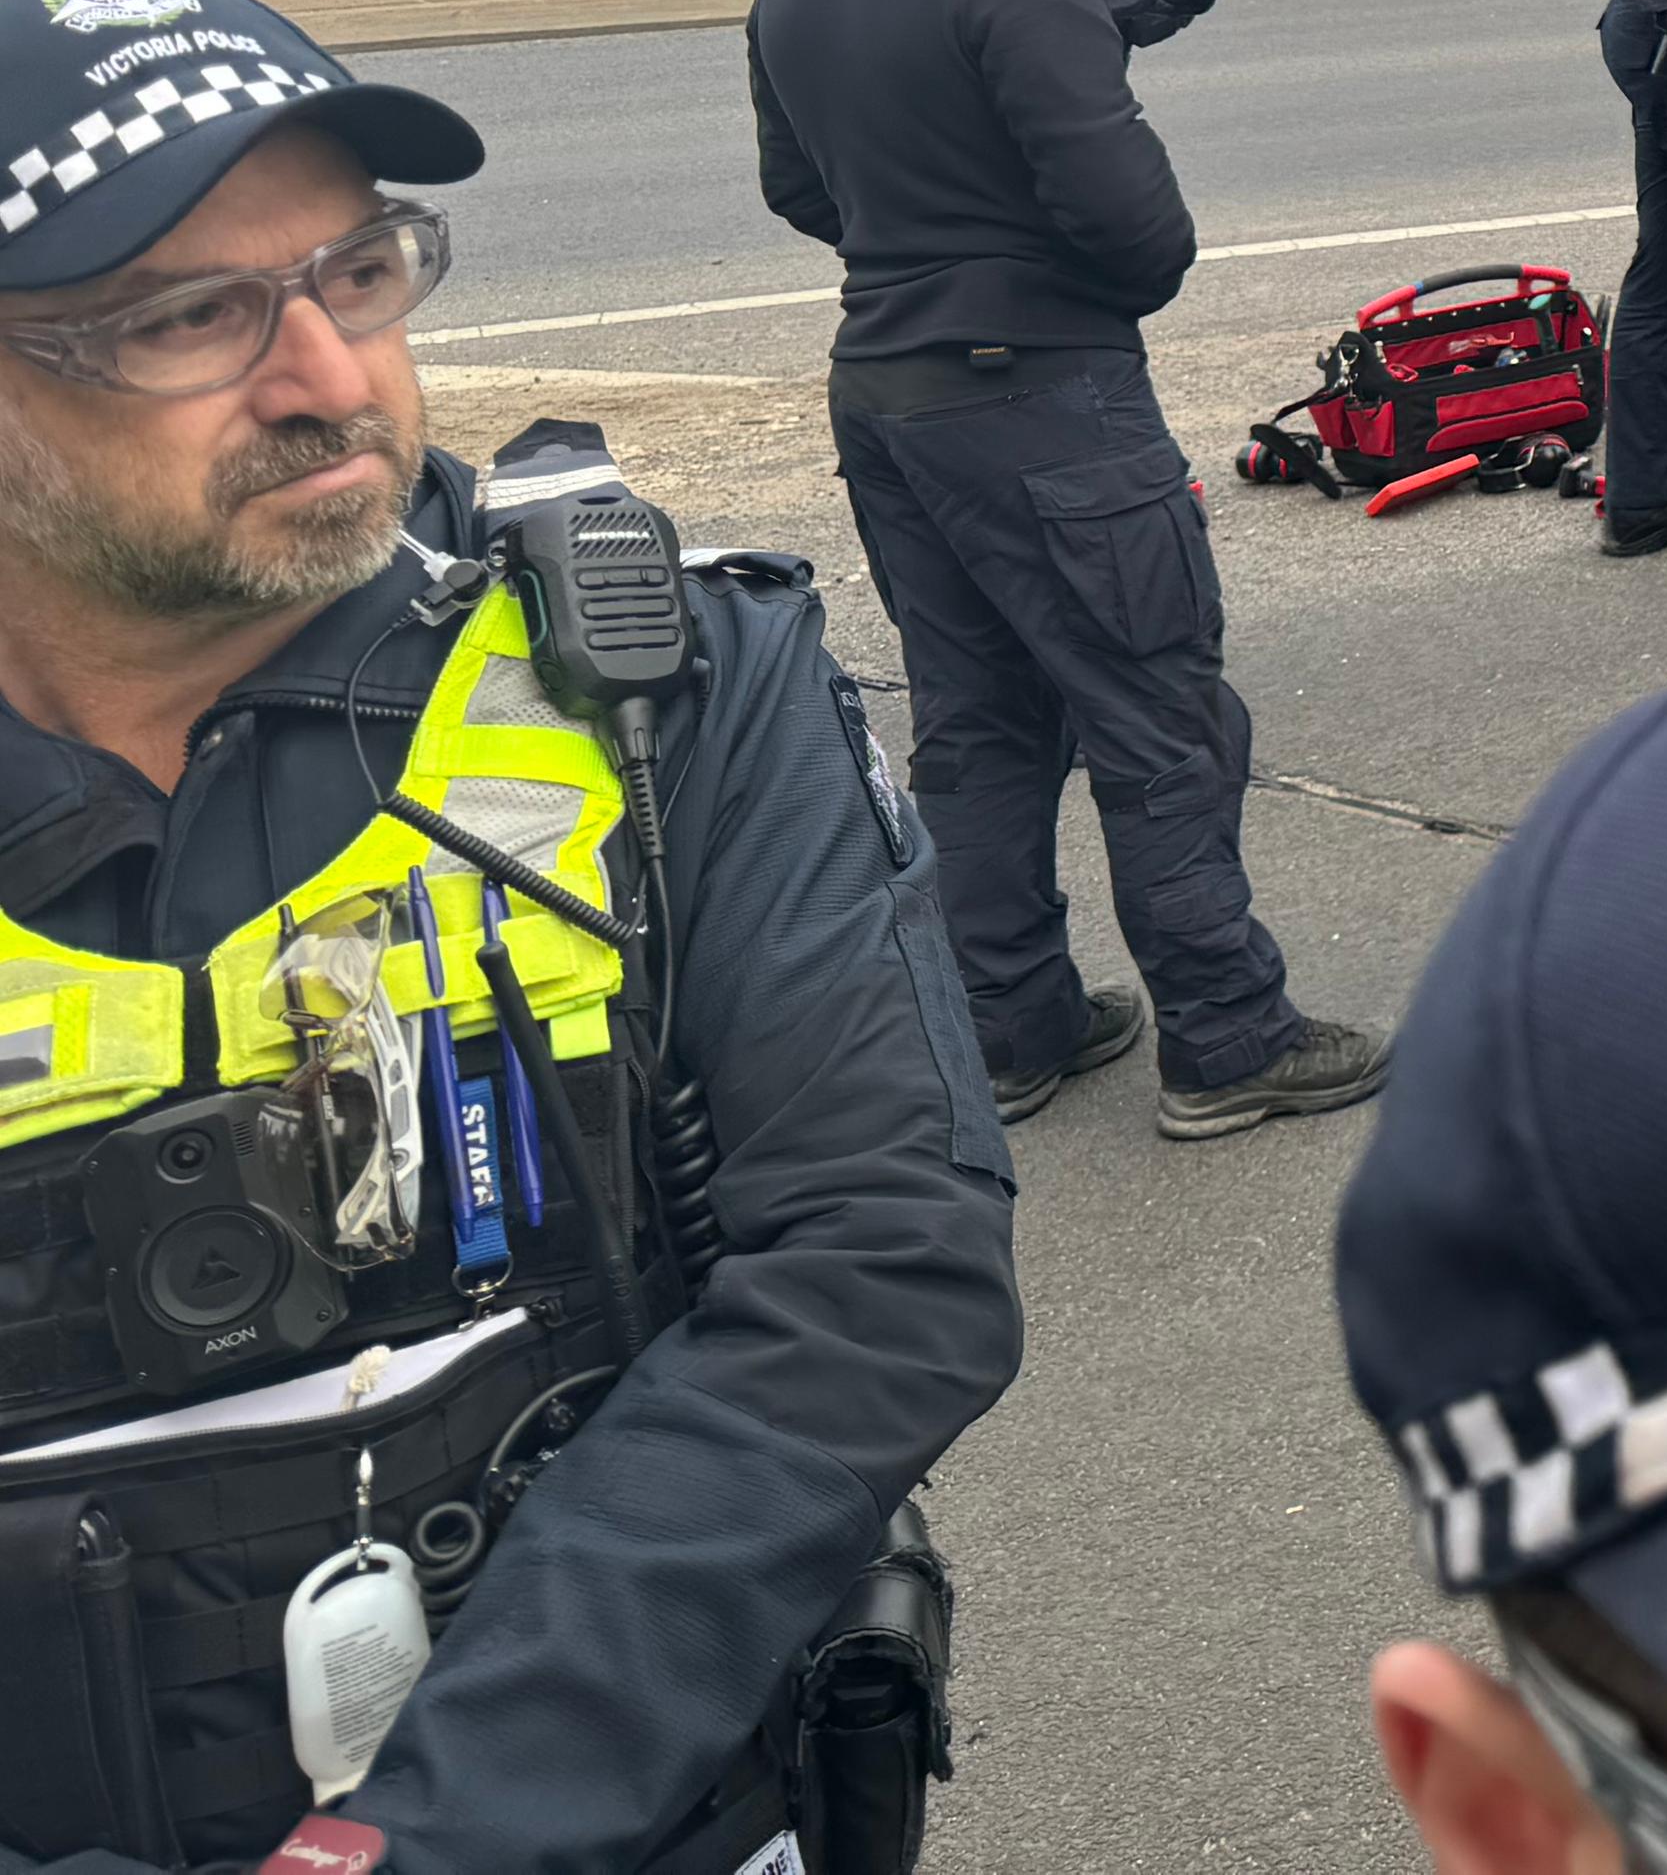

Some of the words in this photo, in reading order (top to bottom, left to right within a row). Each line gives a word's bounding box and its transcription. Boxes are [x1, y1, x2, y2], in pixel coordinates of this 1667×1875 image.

[85, 33, 193, 87] VICTORIA
[192, 29, 267, 56] POLICE
[578, 531, 649, 541] MOTOROLA
[204, 1325, 257, 1356] AXON
